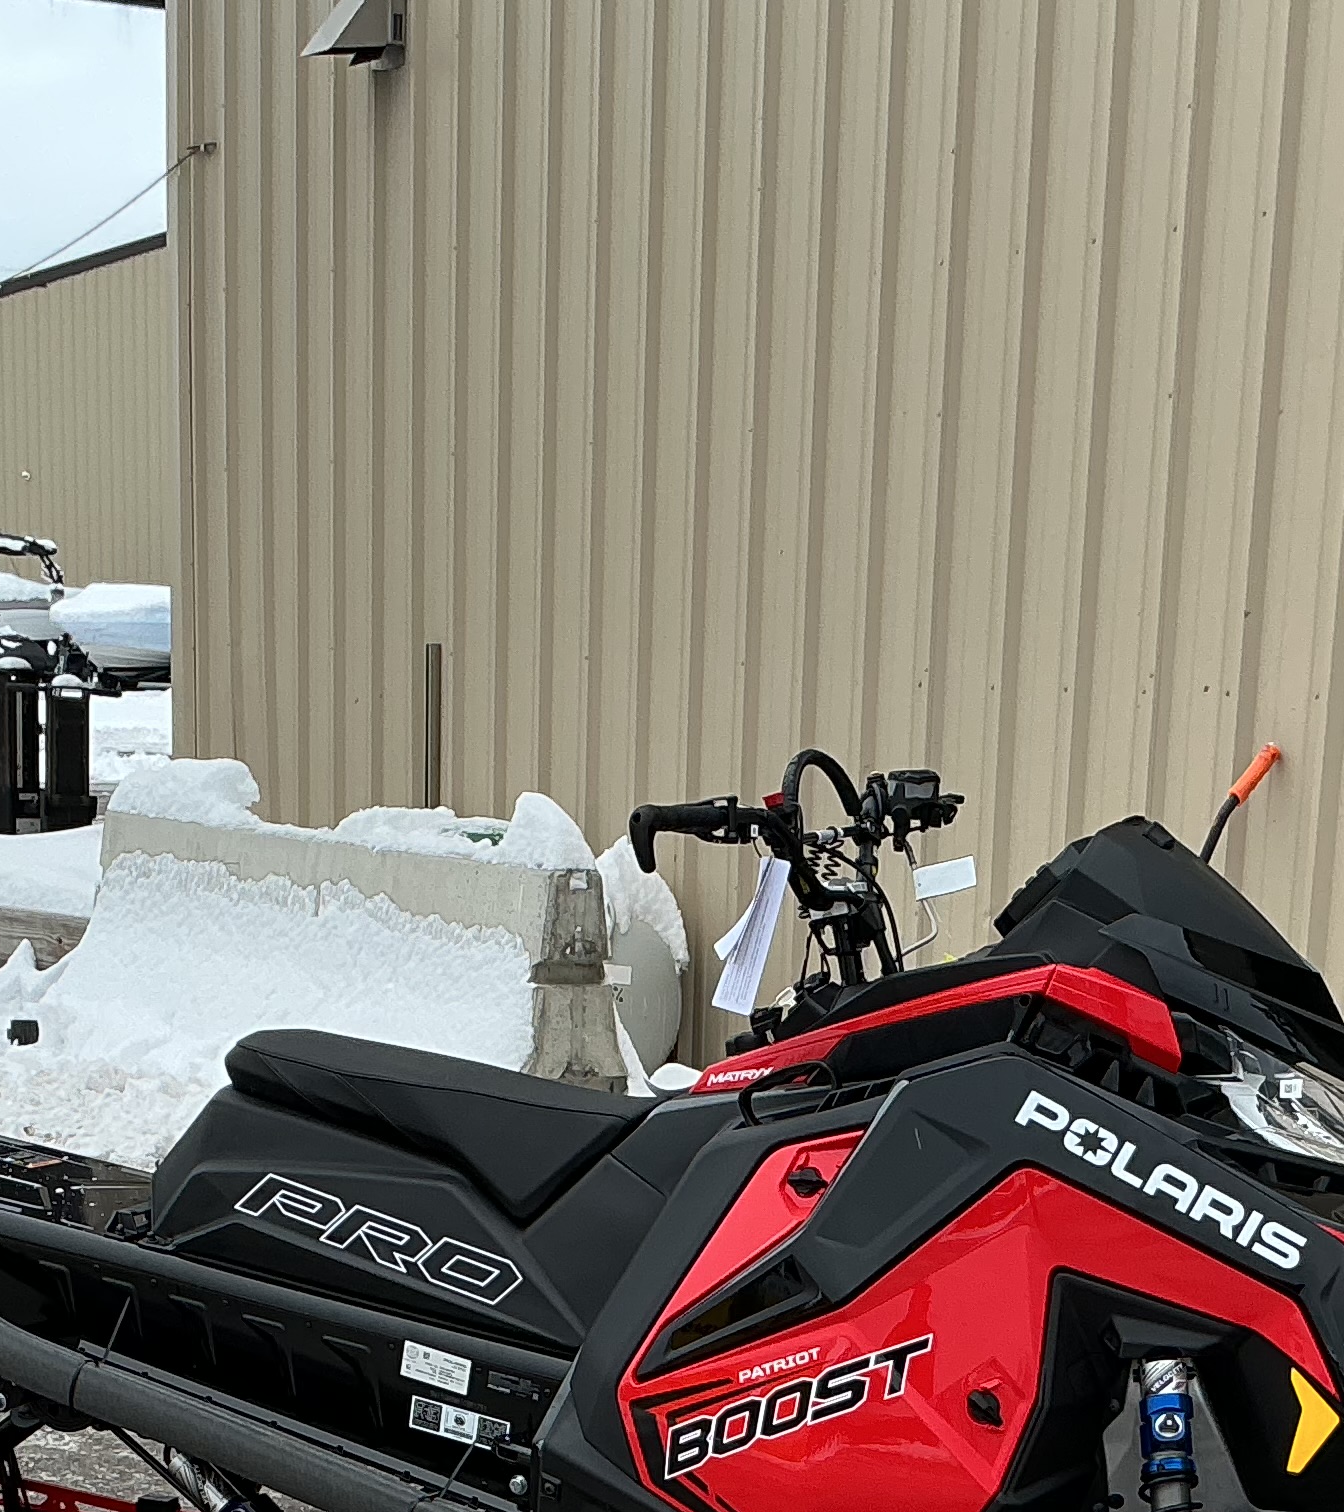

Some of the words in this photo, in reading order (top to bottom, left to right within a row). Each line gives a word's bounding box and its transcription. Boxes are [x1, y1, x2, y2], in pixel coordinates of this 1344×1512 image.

[233, 1172, 524, 1306] PRO
[1014, 1090, 1308, 1269] POLARIS
[664, 1332, 934, 1481] BOOST
[738, 1346, 821, 1384] PATRIOT
